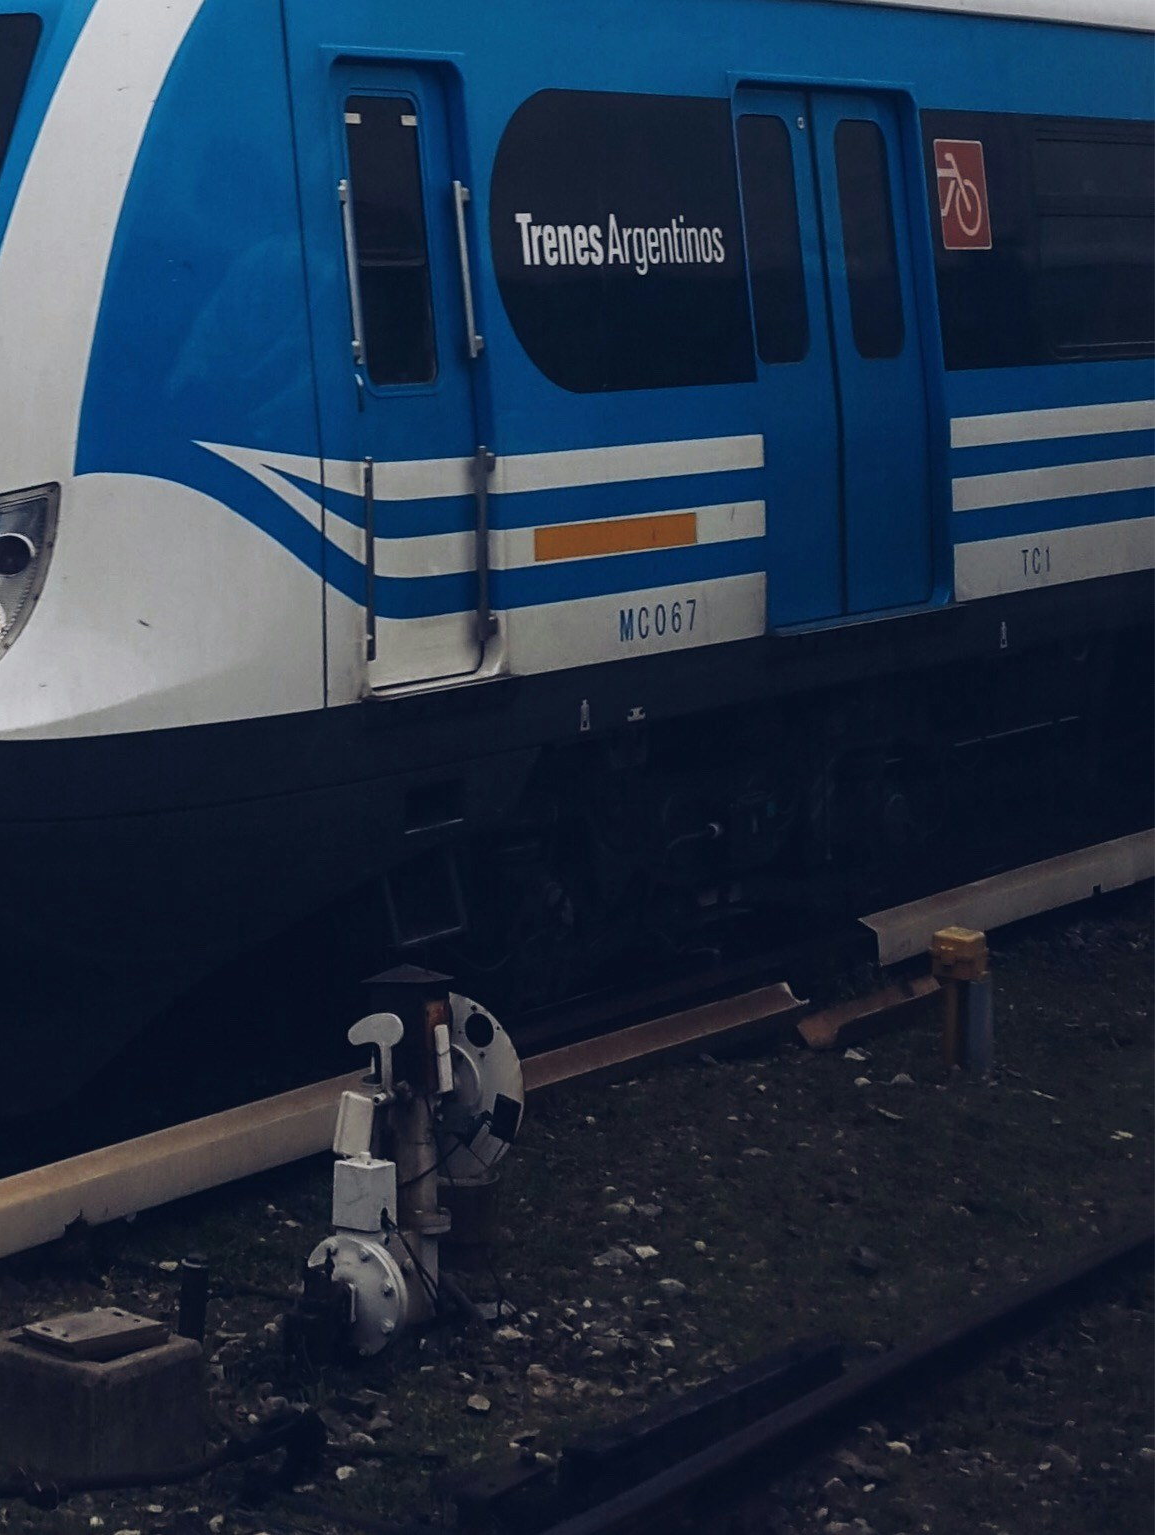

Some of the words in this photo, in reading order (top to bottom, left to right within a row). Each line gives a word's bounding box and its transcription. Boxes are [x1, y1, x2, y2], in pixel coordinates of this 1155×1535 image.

[515, 213, 604, 266] Trenes
[608, 213, 725, 275] Argentinos
[1021, 546, 1051, 576] TC1
[620, 599, 696, 642] MC067
